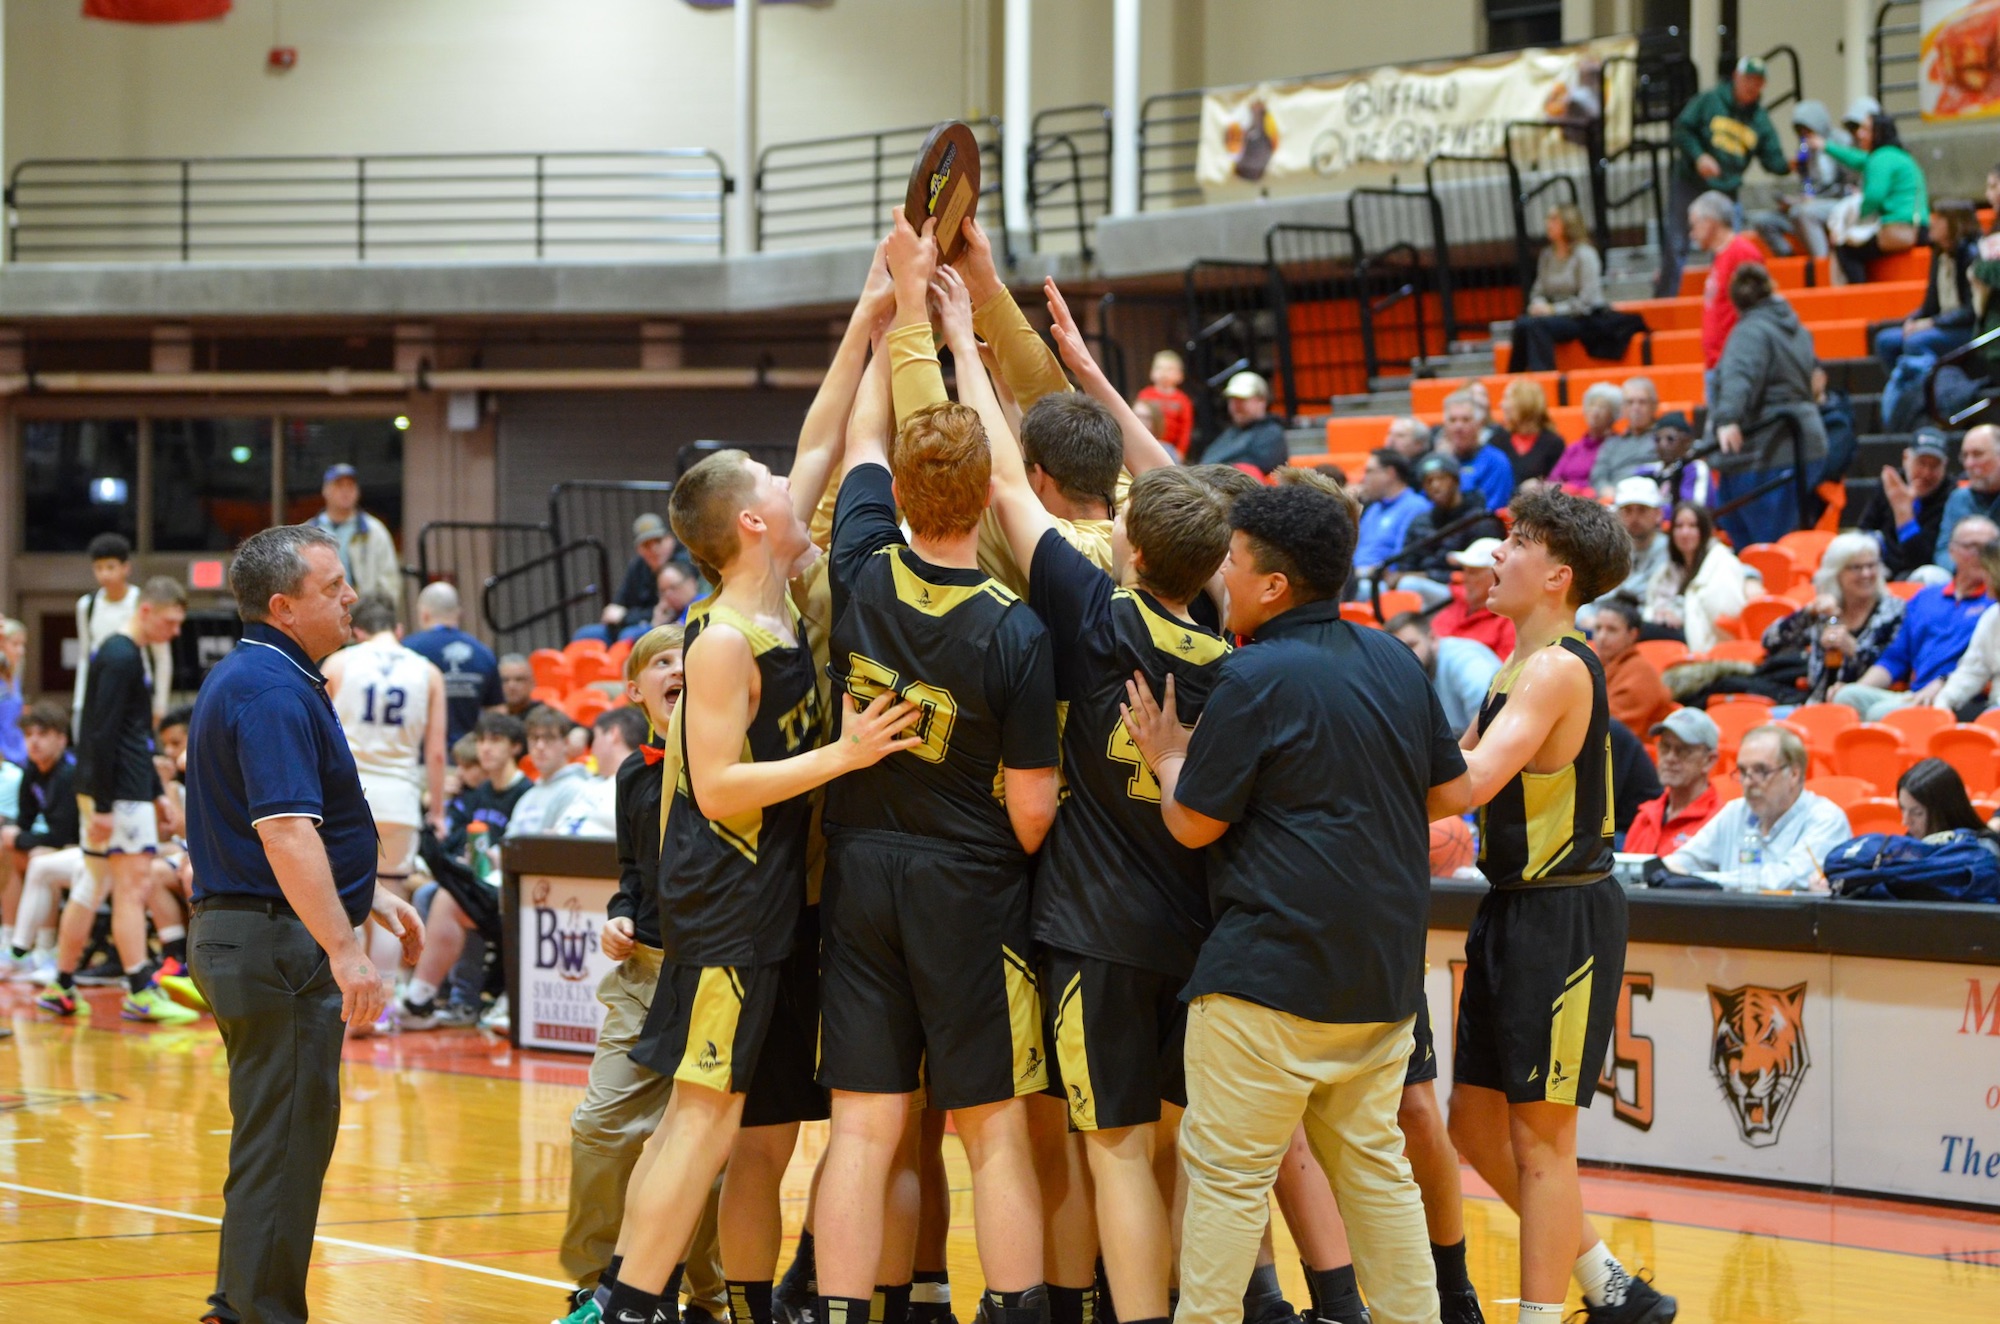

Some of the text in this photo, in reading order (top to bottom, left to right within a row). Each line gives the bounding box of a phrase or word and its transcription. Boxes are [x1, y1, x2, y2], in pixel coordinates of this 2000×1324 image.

[1388, 117, 1504, 164] BREWER
[361, 683, 407, 725] 12
[533, 1001, 598, 1023] BARRELS
